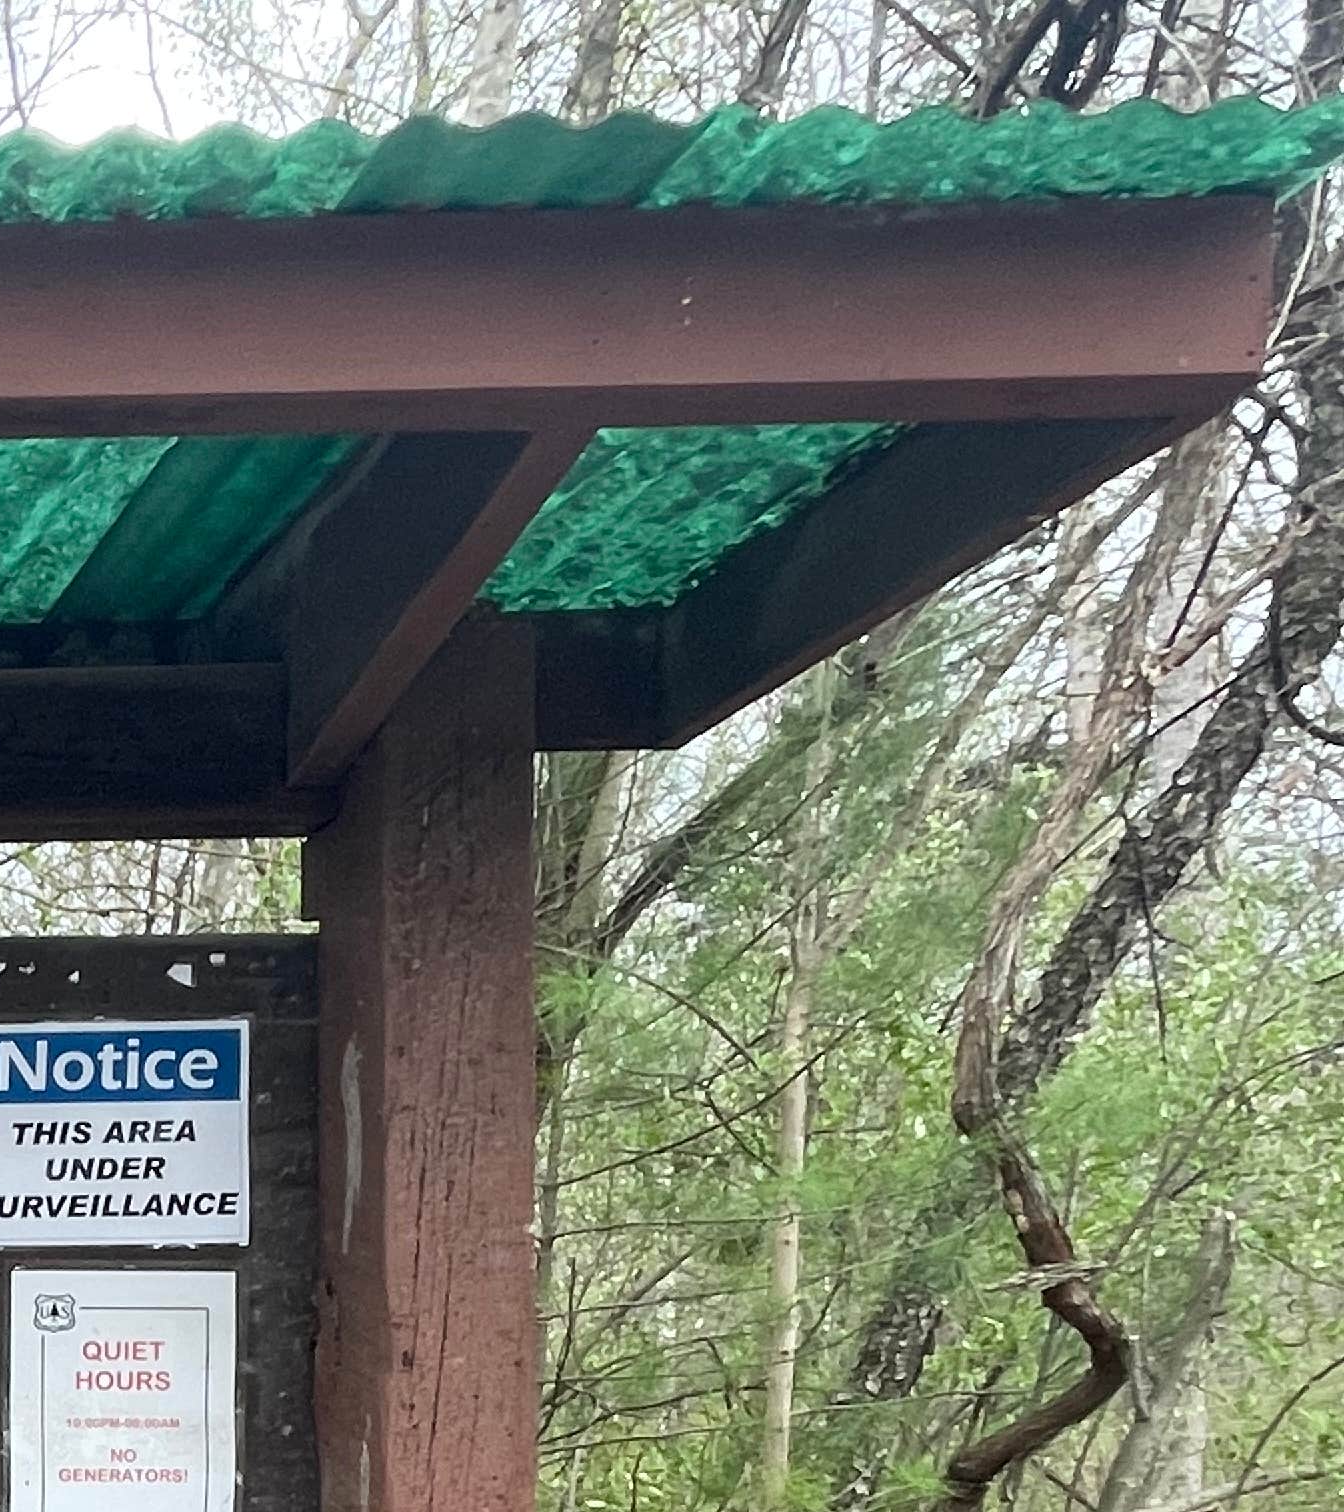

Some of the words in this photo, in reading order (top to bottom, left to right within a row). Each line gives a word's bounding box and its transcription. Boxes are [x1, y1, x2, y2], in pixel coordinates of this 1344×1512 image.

[12, 1121, 93, 1146] THIS
[102, 1120, 196, 1144] AREA
[45, 1156, 166, 1181] UNDER
[82, 1340, 165, 1362] QUIET
[75, 1370, 171, 1391] HOURS
[110, 1448, 137, 1463] NO
[58, 1467, 188, 1483] GENERATORS!
